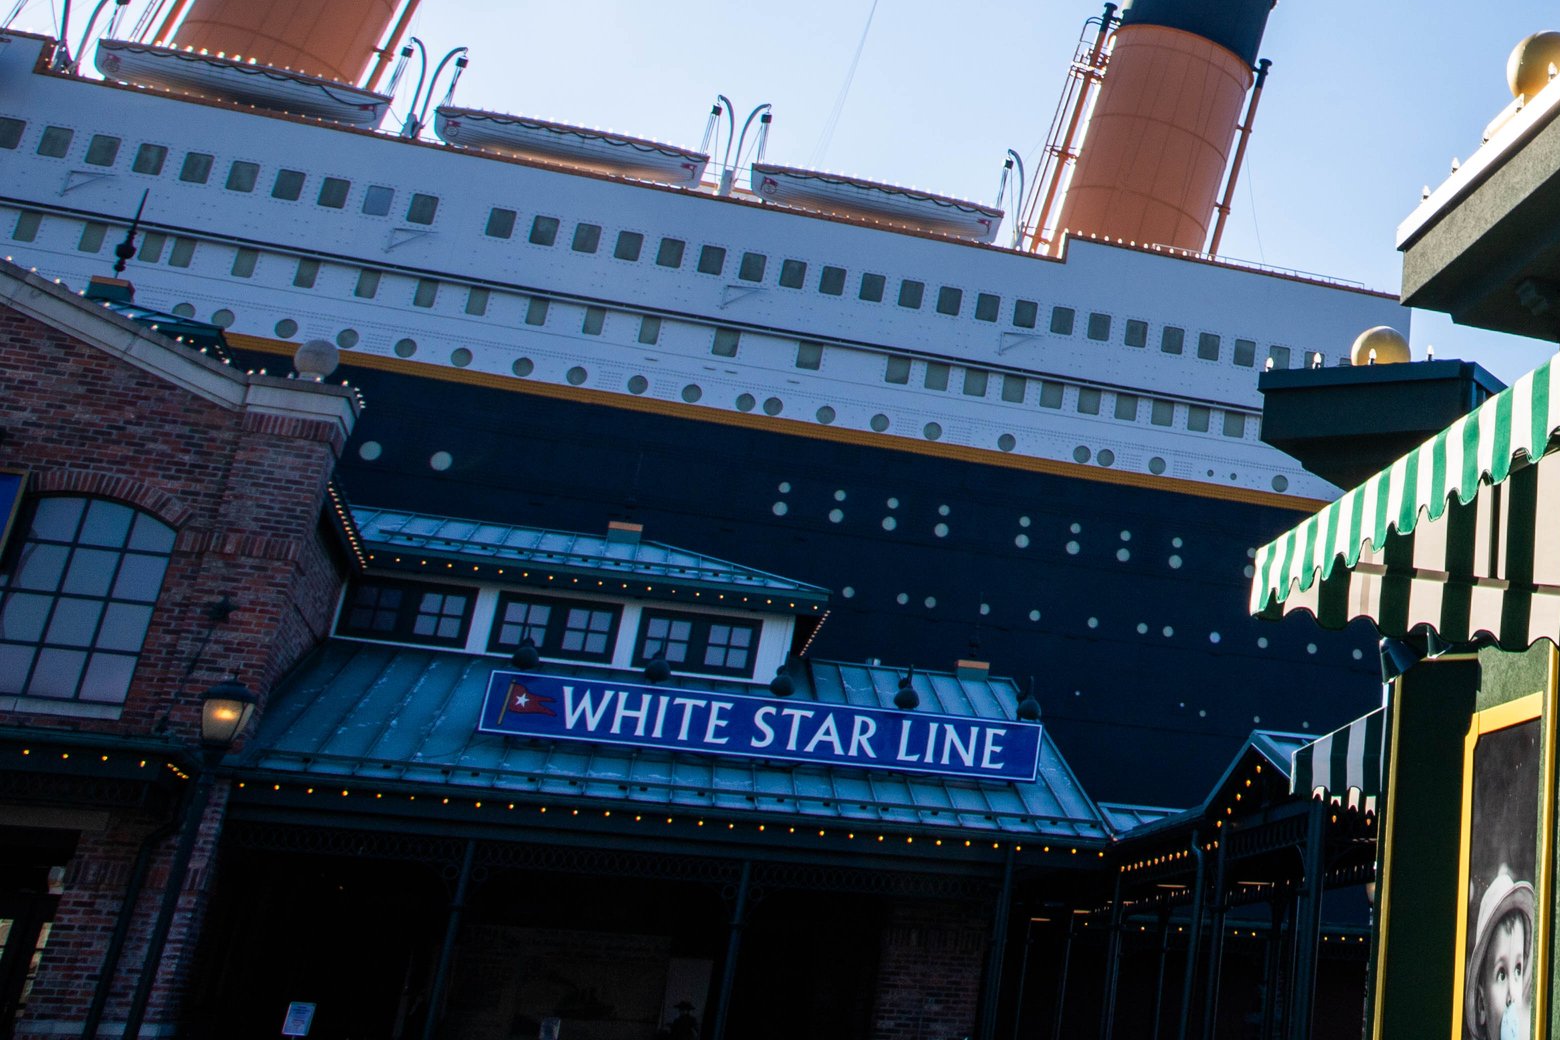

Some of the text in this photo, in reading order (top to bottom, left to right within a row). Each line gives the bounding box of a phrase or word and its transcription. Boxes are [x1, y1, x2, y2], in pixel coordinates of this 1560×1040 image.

[562, 685, 1007, 770] WHITE STAR LINE
